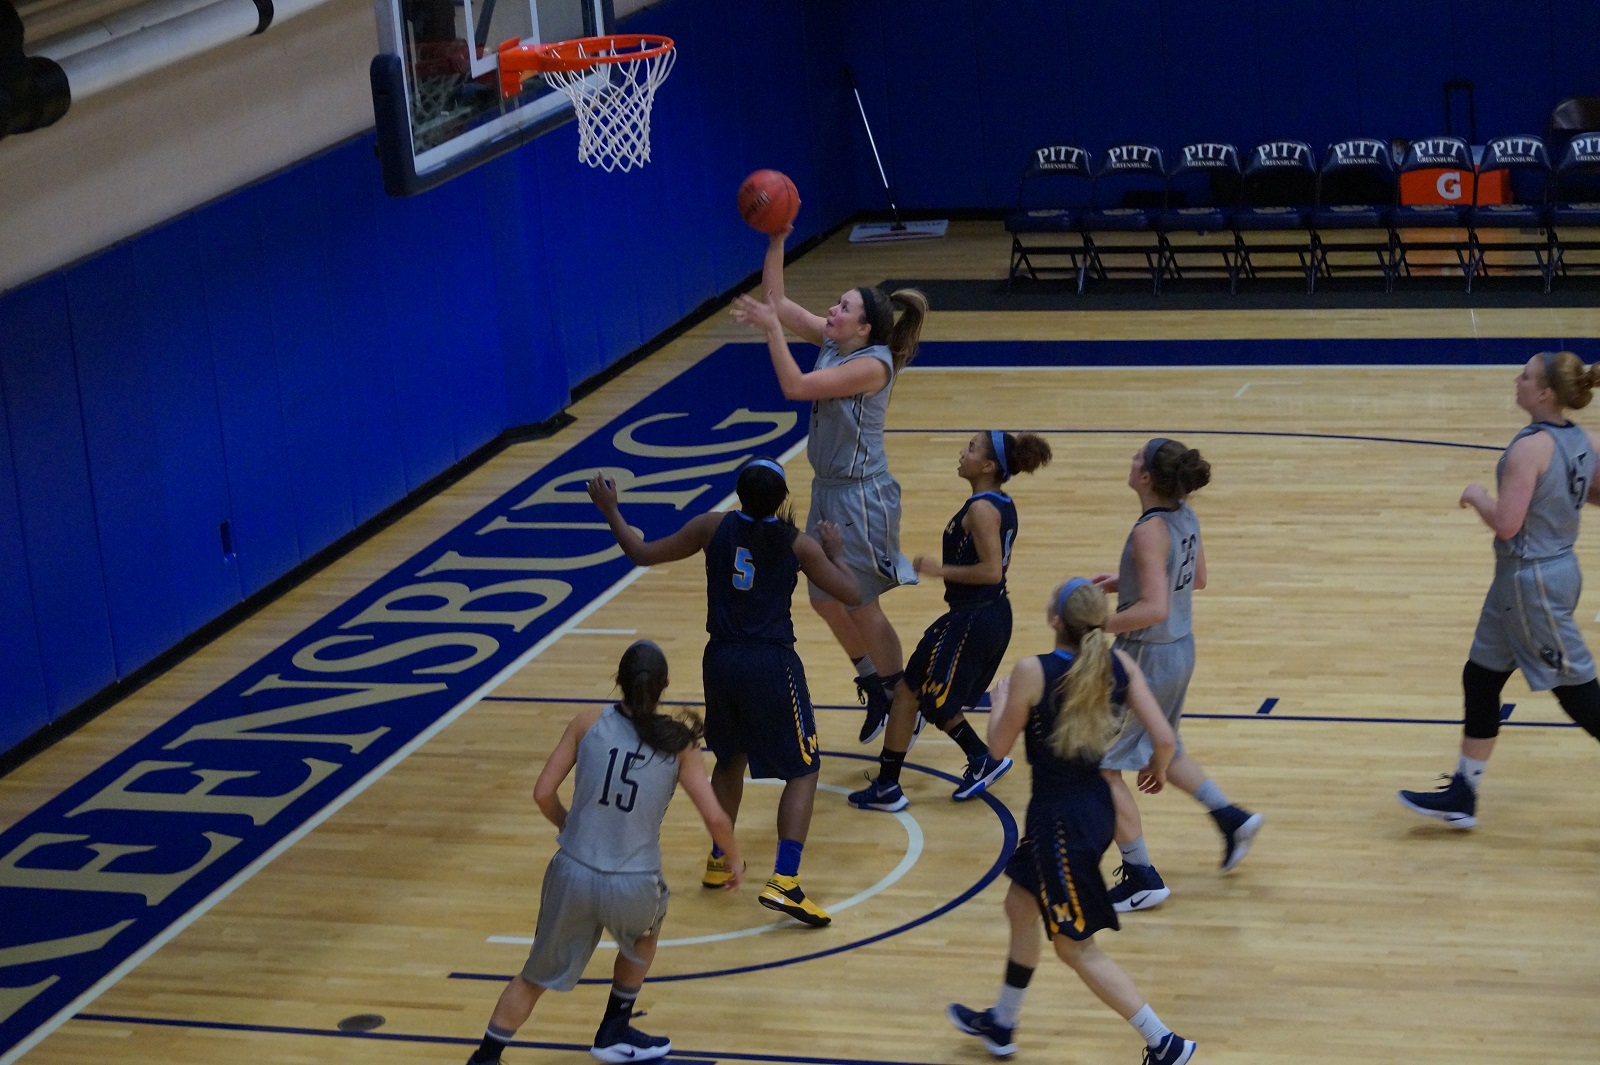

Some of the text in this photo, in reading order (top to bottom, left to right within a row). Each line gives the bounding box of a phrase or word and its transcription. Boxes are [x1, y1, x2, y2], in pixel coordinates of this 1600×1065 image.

[1037, 146, 1083, 163] PITT
[1108, 145, 1156, 162] PITT
[1183, 143, 1233, 160] PITT
[1257, 142, 1307, 160] PITT
[1334, 140, 1384, 158] PITT
[1413, 139, 1463, 157] PITT
[1492, 138, 1543, 157] PITT
[1111, 161, 1148, 169] GREENSBURG
[1338, 157, 1376, 165] GREENSBURG
[1496, 155, 1534, 163] GREENSBURG
[1437, 171, 1461, 200] G
[732, 546, 755, 591] 5
[598, 747, 645, 812] 15
